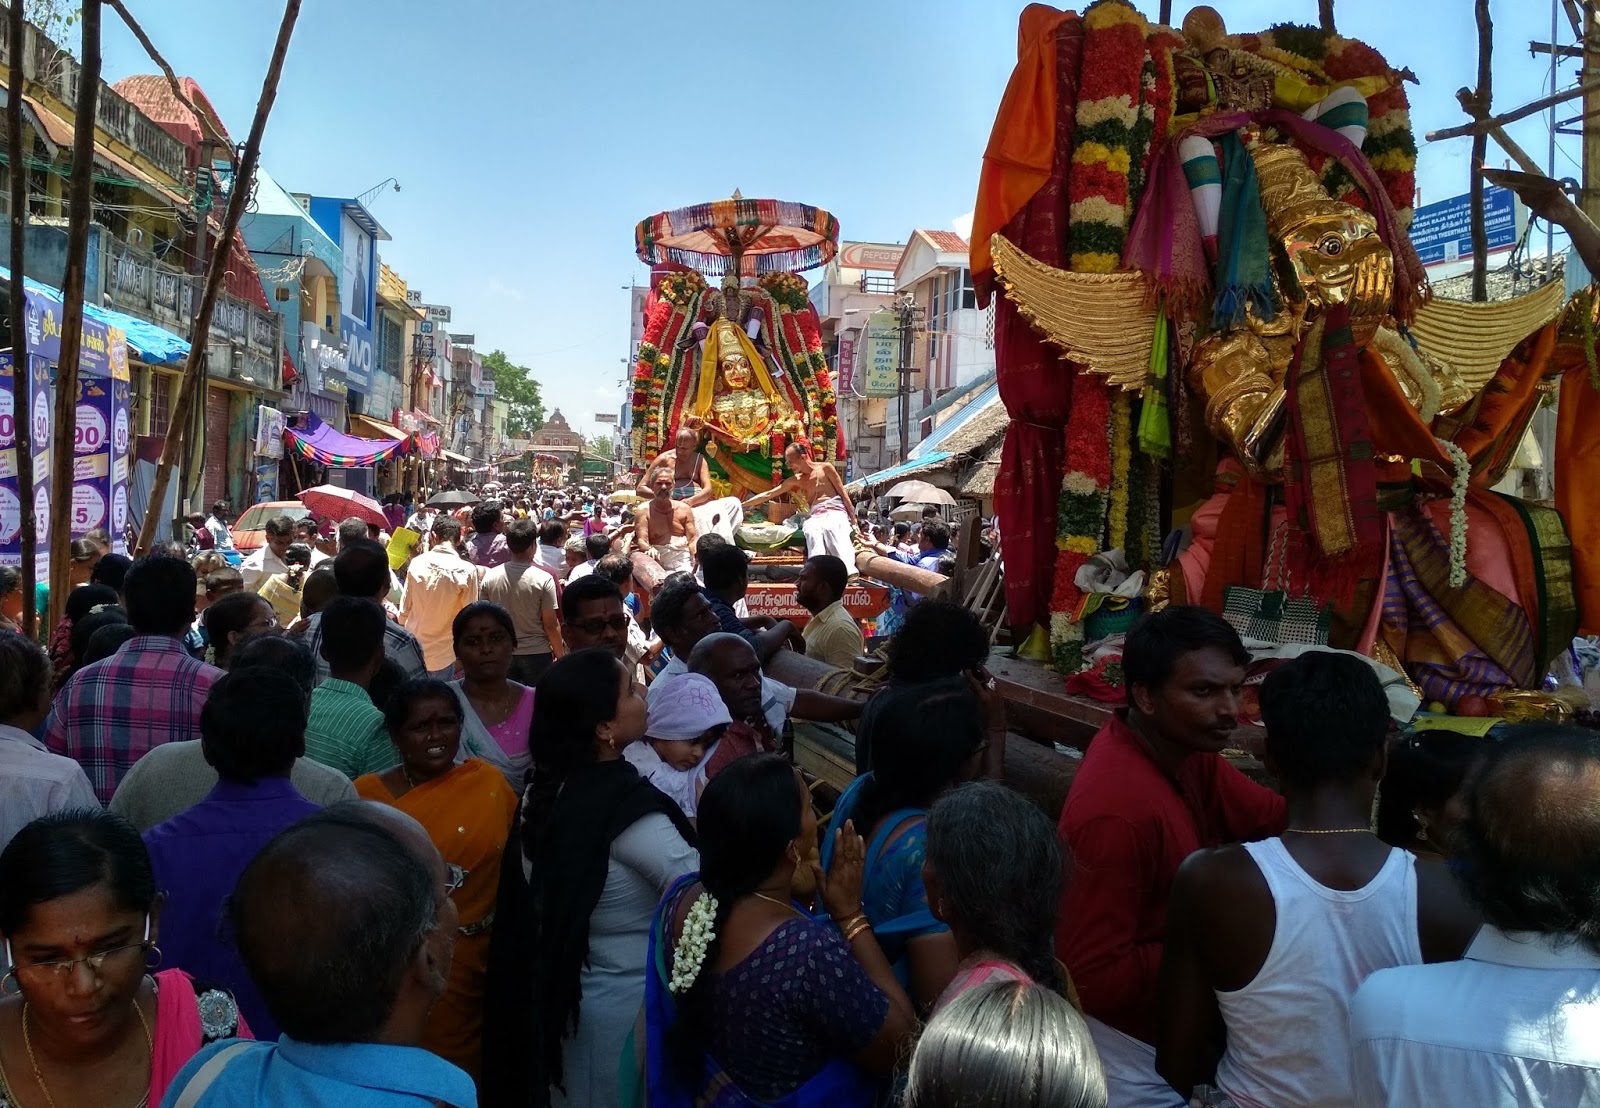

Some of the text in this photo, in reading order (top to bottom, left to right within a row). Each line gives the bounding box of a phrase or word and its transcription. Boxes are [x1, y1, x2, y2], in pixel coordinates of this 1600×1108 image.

[1412, 220, 1430, 230] VYASA
[1431, 216, 1447, 225] RAJA
[1447, 210, 1465, 220] MUTT
[1411, 233, 1438, 246] GANNATHA
[863, 250, 903, 261] REPCO BA
[37, 415, 47, 439] 90
[75, 426, 99, 446] 90
[117, 428, 127, 447] 90
